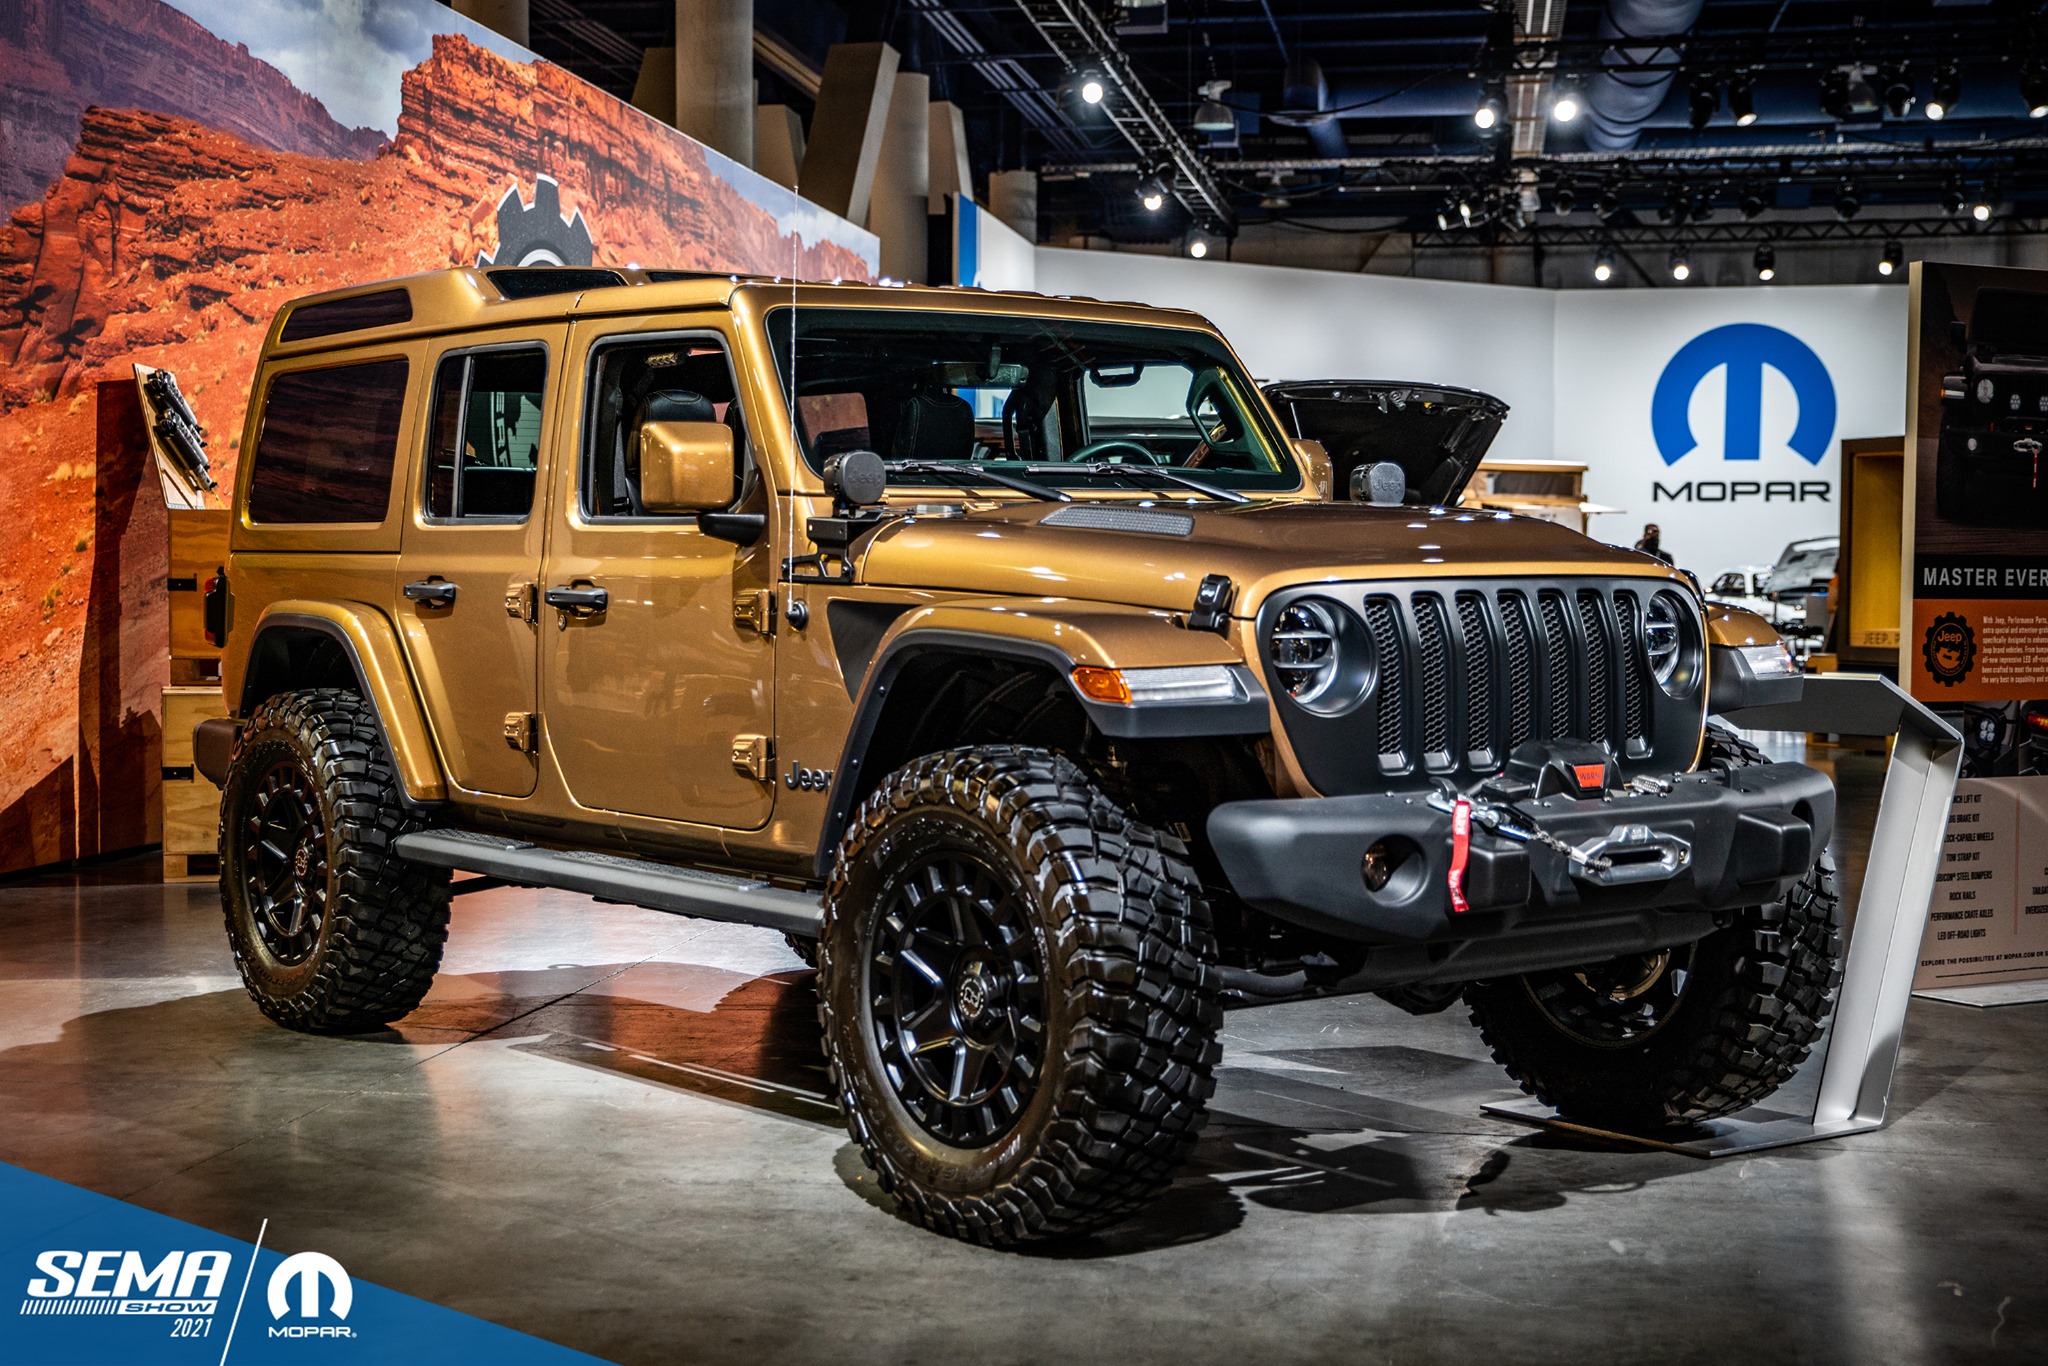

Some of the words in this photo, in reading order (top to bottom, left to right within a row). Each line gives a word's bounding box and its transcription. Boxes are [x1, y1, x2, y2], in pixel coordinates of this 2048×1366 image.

[848, 468, 882, 487] Jeep
[1373, 478, 1403, 495] Jeep
[1652, 481, 1831, 502] MOPAR
[1923, 567, 1998, 586] MASTER
[1937, 630, 1963, 645] Jeep
[2022, 655, 2031, 664] LED
[1580, 771, 1600, 780] WARN
[1963, 794, 1974, 804] LIFT
[1976, 832, 1994, 841] WHEELS
[1946, 853, 1957, 862] TOW
[1957, 852, 1972, 862] STRAP
[1956, 871, 1970, 881] STEEL
[1970, 870, 1993, 880] BUMPERS
[1949, 891, 1962, 901] ROCK
[1962, 891, 1976, 900] RAILS
[1930, 910, 1964, 921] PERFORMANCE
[1964, 909, 1979, 920] CRATE
[1979, 908, 1994, 918] AXLES
[1970, 928, 1986, 938] LIGHTS
[1921, 959, 1945, 967] EXPLORE
[1947, 957, 1957, 965] THE
